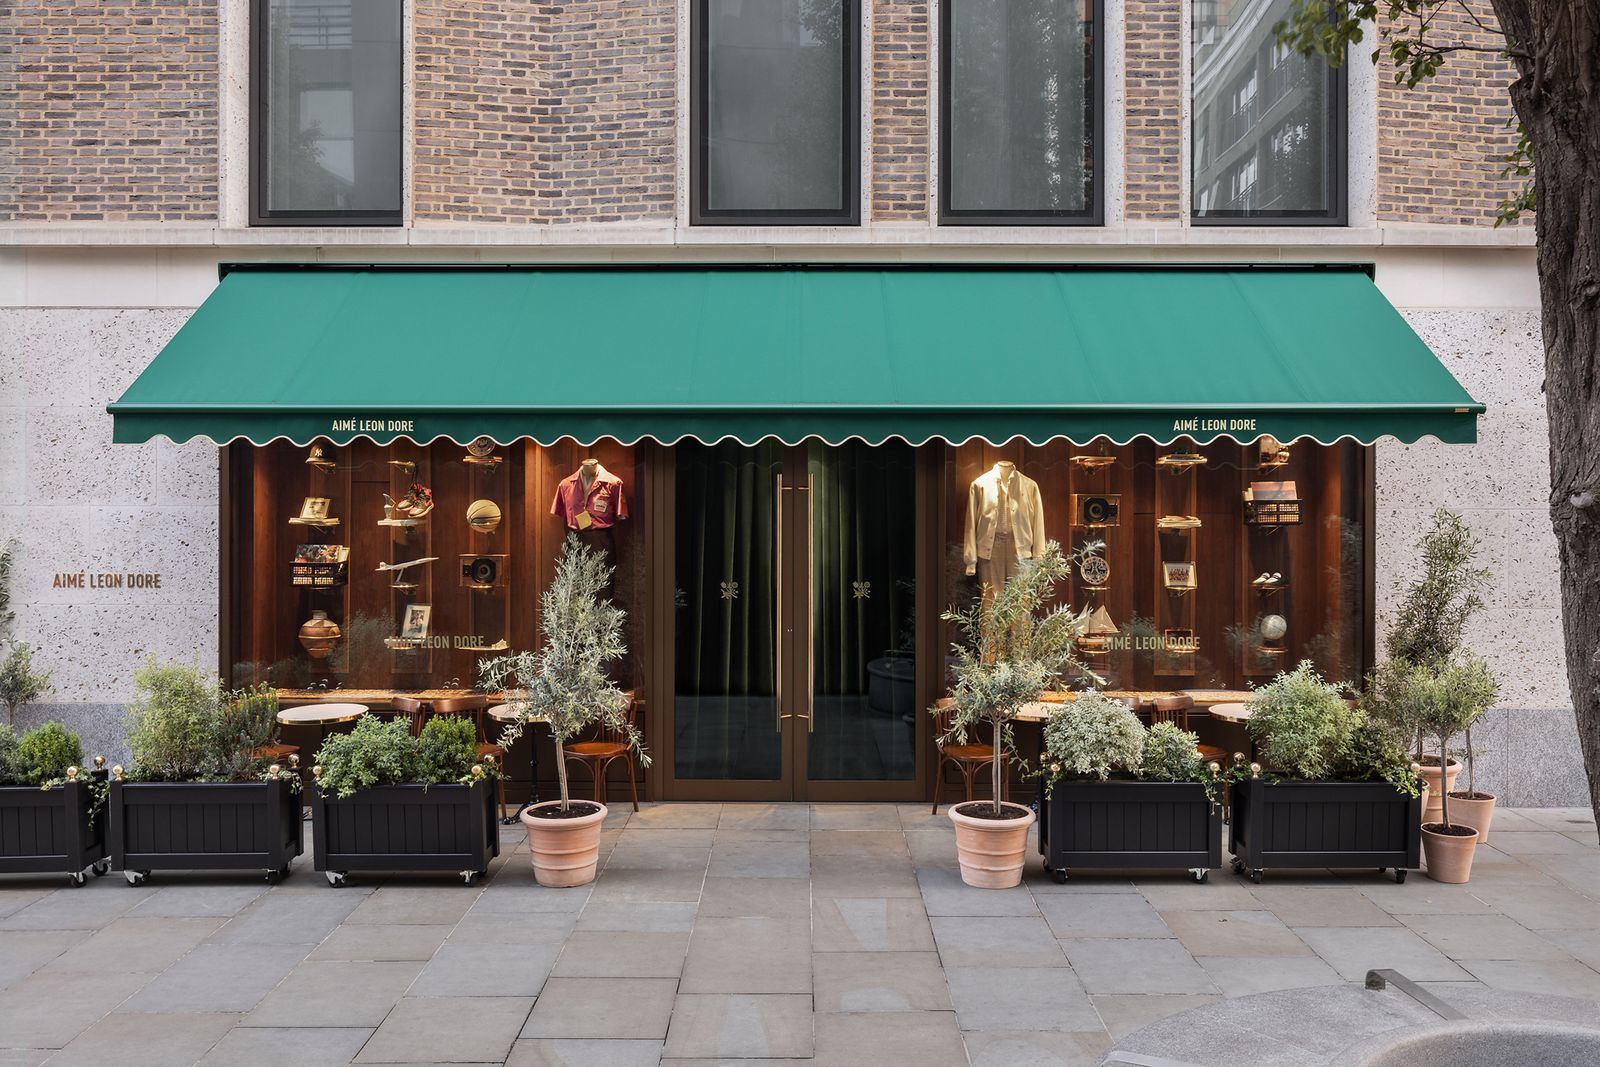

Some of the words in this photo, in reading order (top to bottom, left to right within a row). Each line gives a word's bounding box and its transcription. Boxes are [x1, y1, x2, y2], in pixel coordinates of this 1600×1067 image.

[332, 417, 357, 431] AIMÉ
[359, 420, 385, 432] LEON
[388, 420, 414, 432] DORE
[1173, 416, 1198, 431] AIMÉ
[1201, 419, 1227, 431] LEON
[1230, 419, 1257, 431] DORE
[52, 568, 85, 589] AIMÉ
[90, 573, 123, 589] LEON
[127, 573, 161, 589] DORE
[420, 635, 450, 649] LEON
[454, 635, 485, 649] DORE
[1102, 632, 1131, 650] AIMÉ
[1135, 636, 1165, 650] LEON
[1169, 636, 1201, 650] DORE
